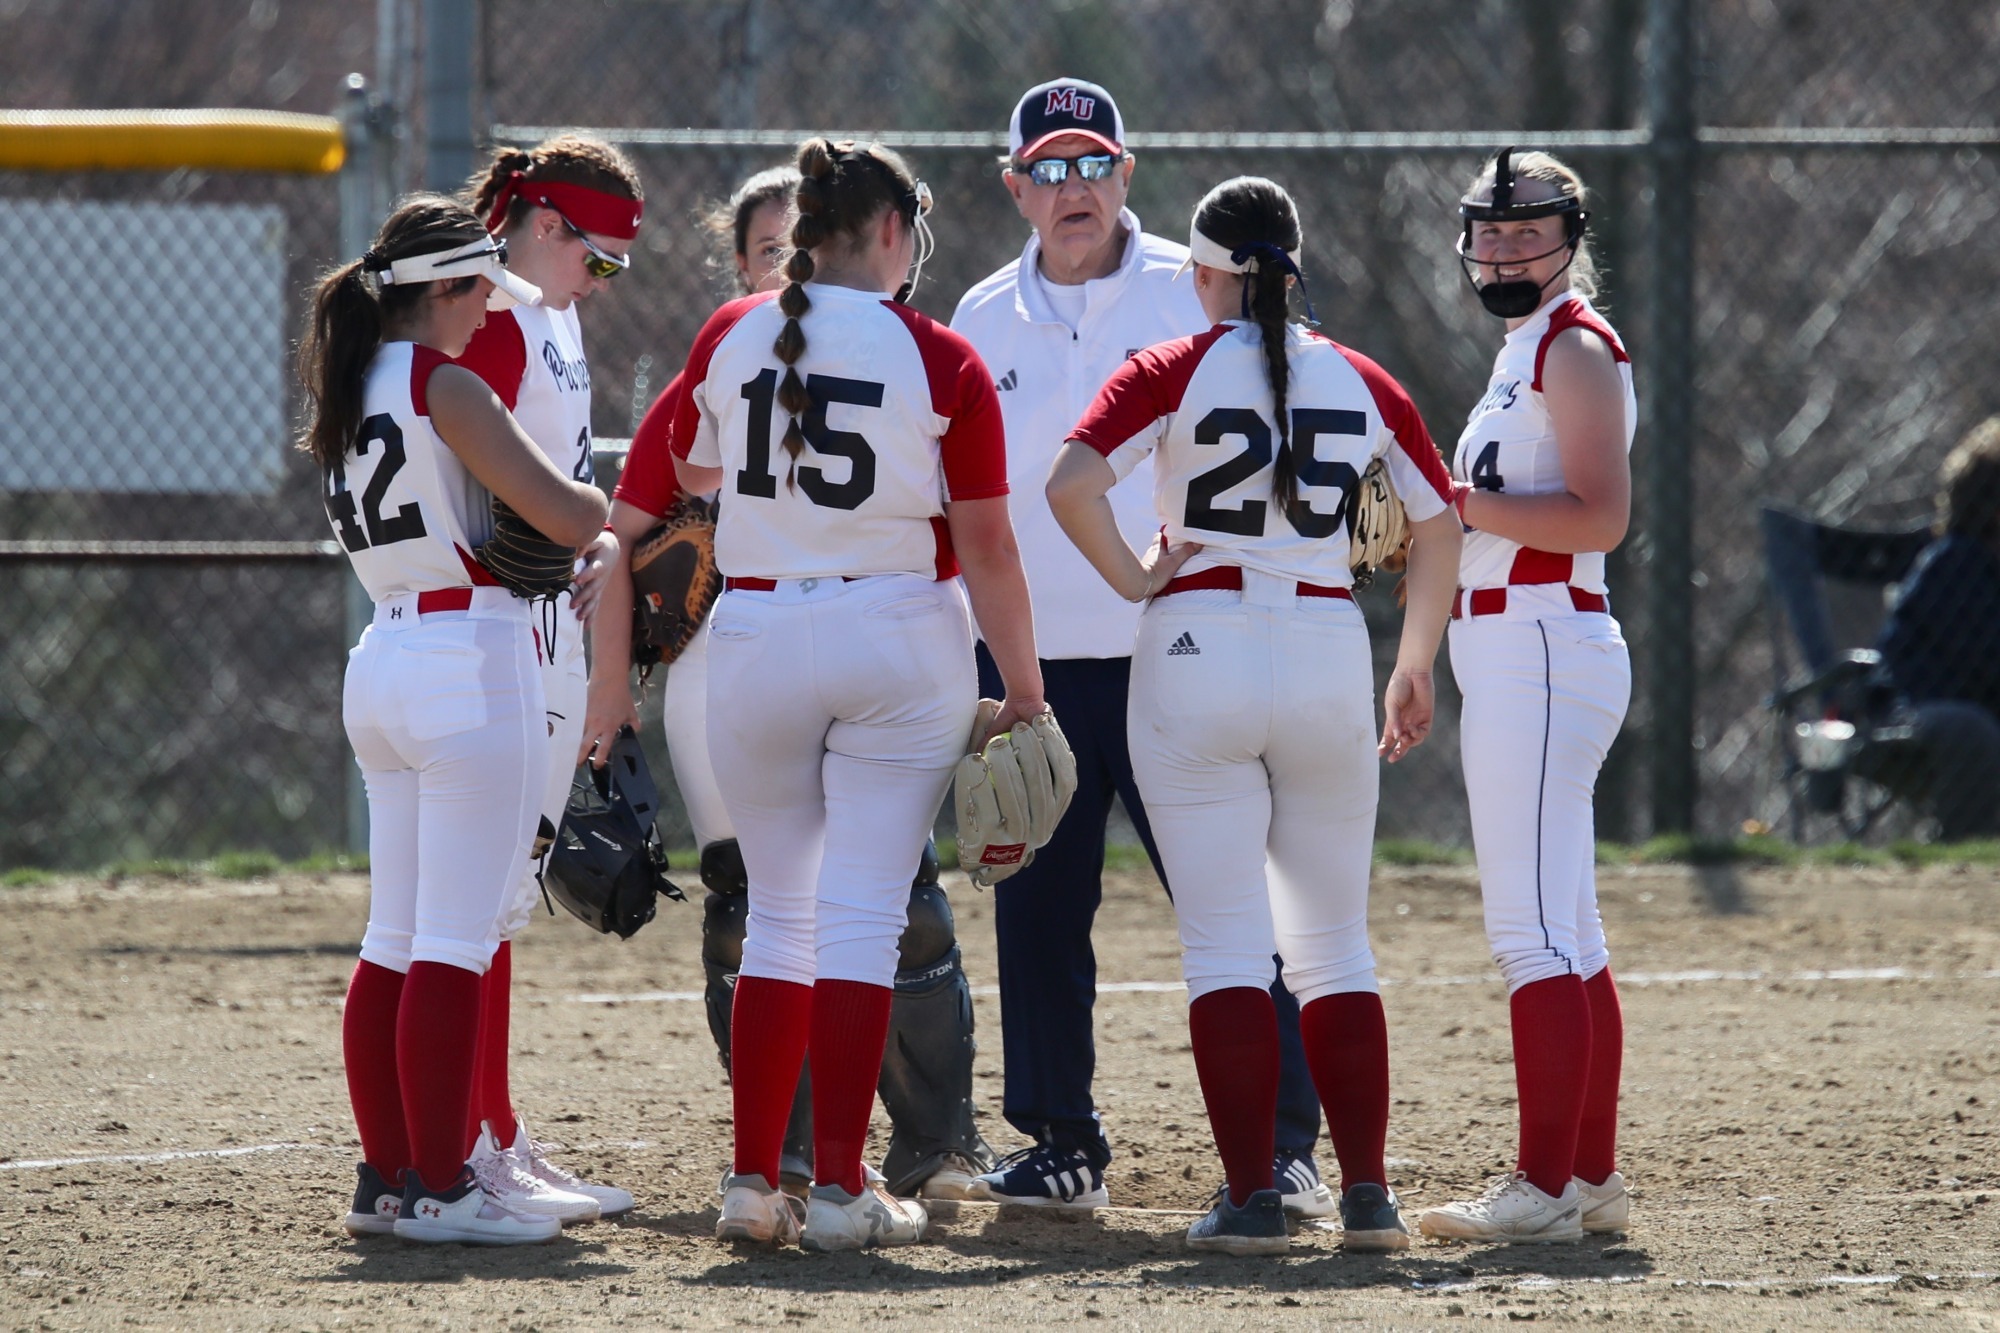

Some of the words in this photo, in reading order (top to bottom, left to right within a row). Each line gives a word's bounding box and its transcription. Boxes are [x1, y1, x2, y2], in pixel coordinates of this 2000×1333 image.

[1044, 87, 1095, 120] MU
[323, 412, 428, 553] 42
[737, 368, 885, 511] 15
[1184, 408, 1367, 538] 25
[1167, 645, 1201, 656] adidas
